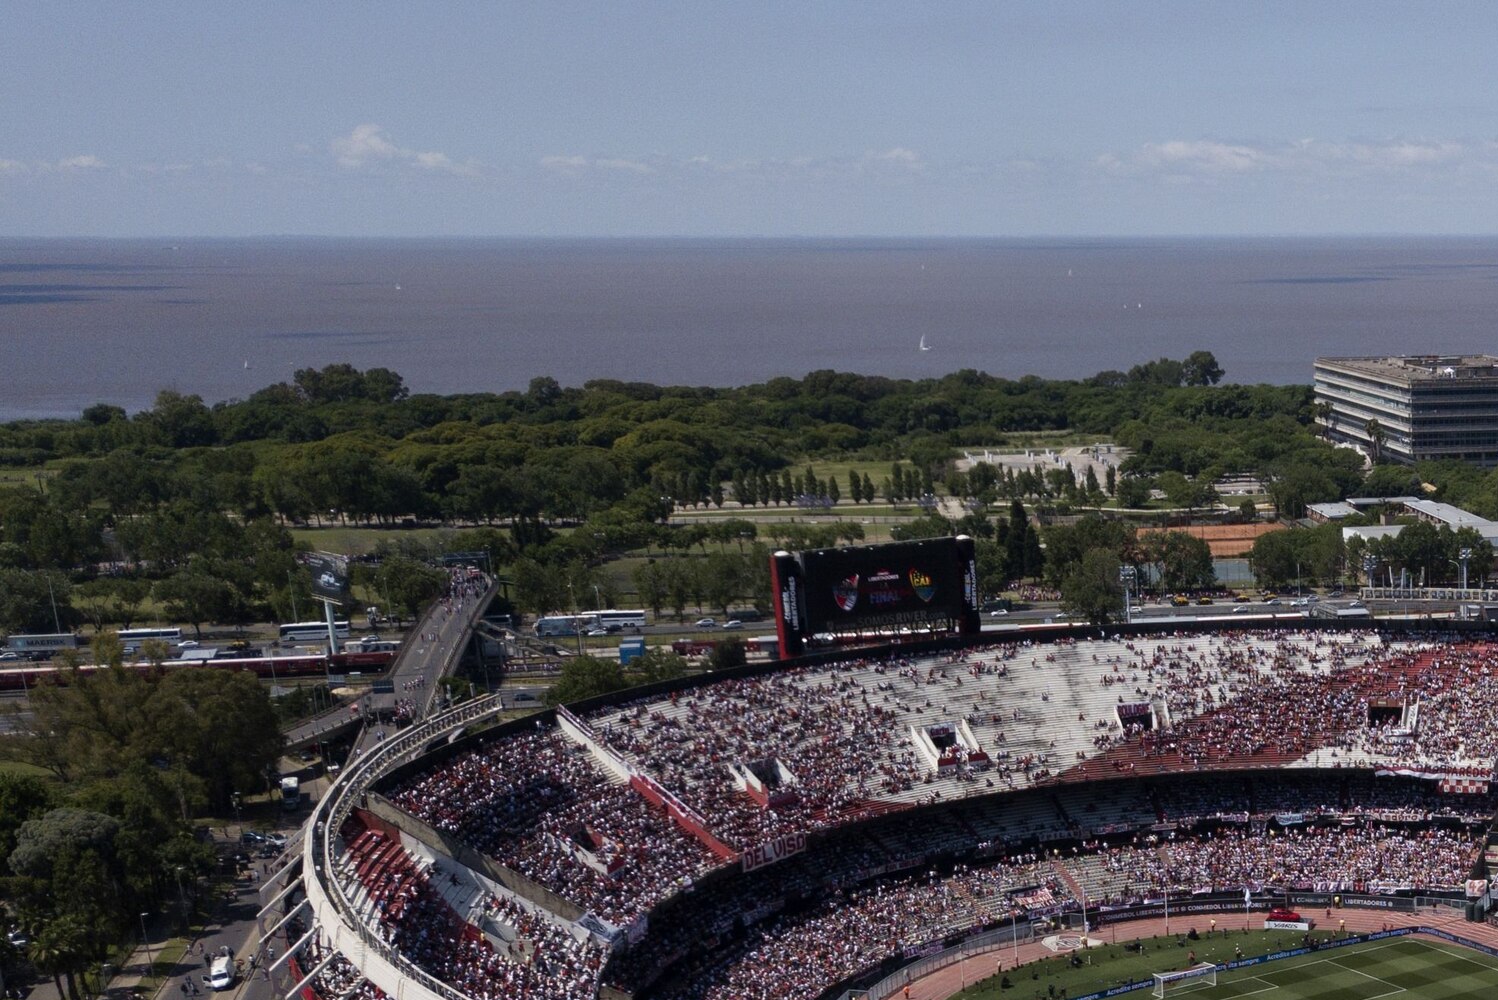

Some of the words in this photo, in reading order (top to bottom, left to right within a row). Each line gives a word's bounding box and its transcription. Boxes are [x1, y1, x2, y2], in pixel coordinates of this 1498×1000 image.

[789, 576, 799, 631] LIBERTADORES
[744, 845, 773, 871] DEL
[773, 835, 806, 860] VISO
[1468, 881, 1485, 893] 42
[1344, 899, 1386, 907] LIBERTADORES
[1368, 930, 1390, 941] Acredite
[1216, 961, 1239, 971] Acreite
[1107, 985, 1131, 996] Acredite
